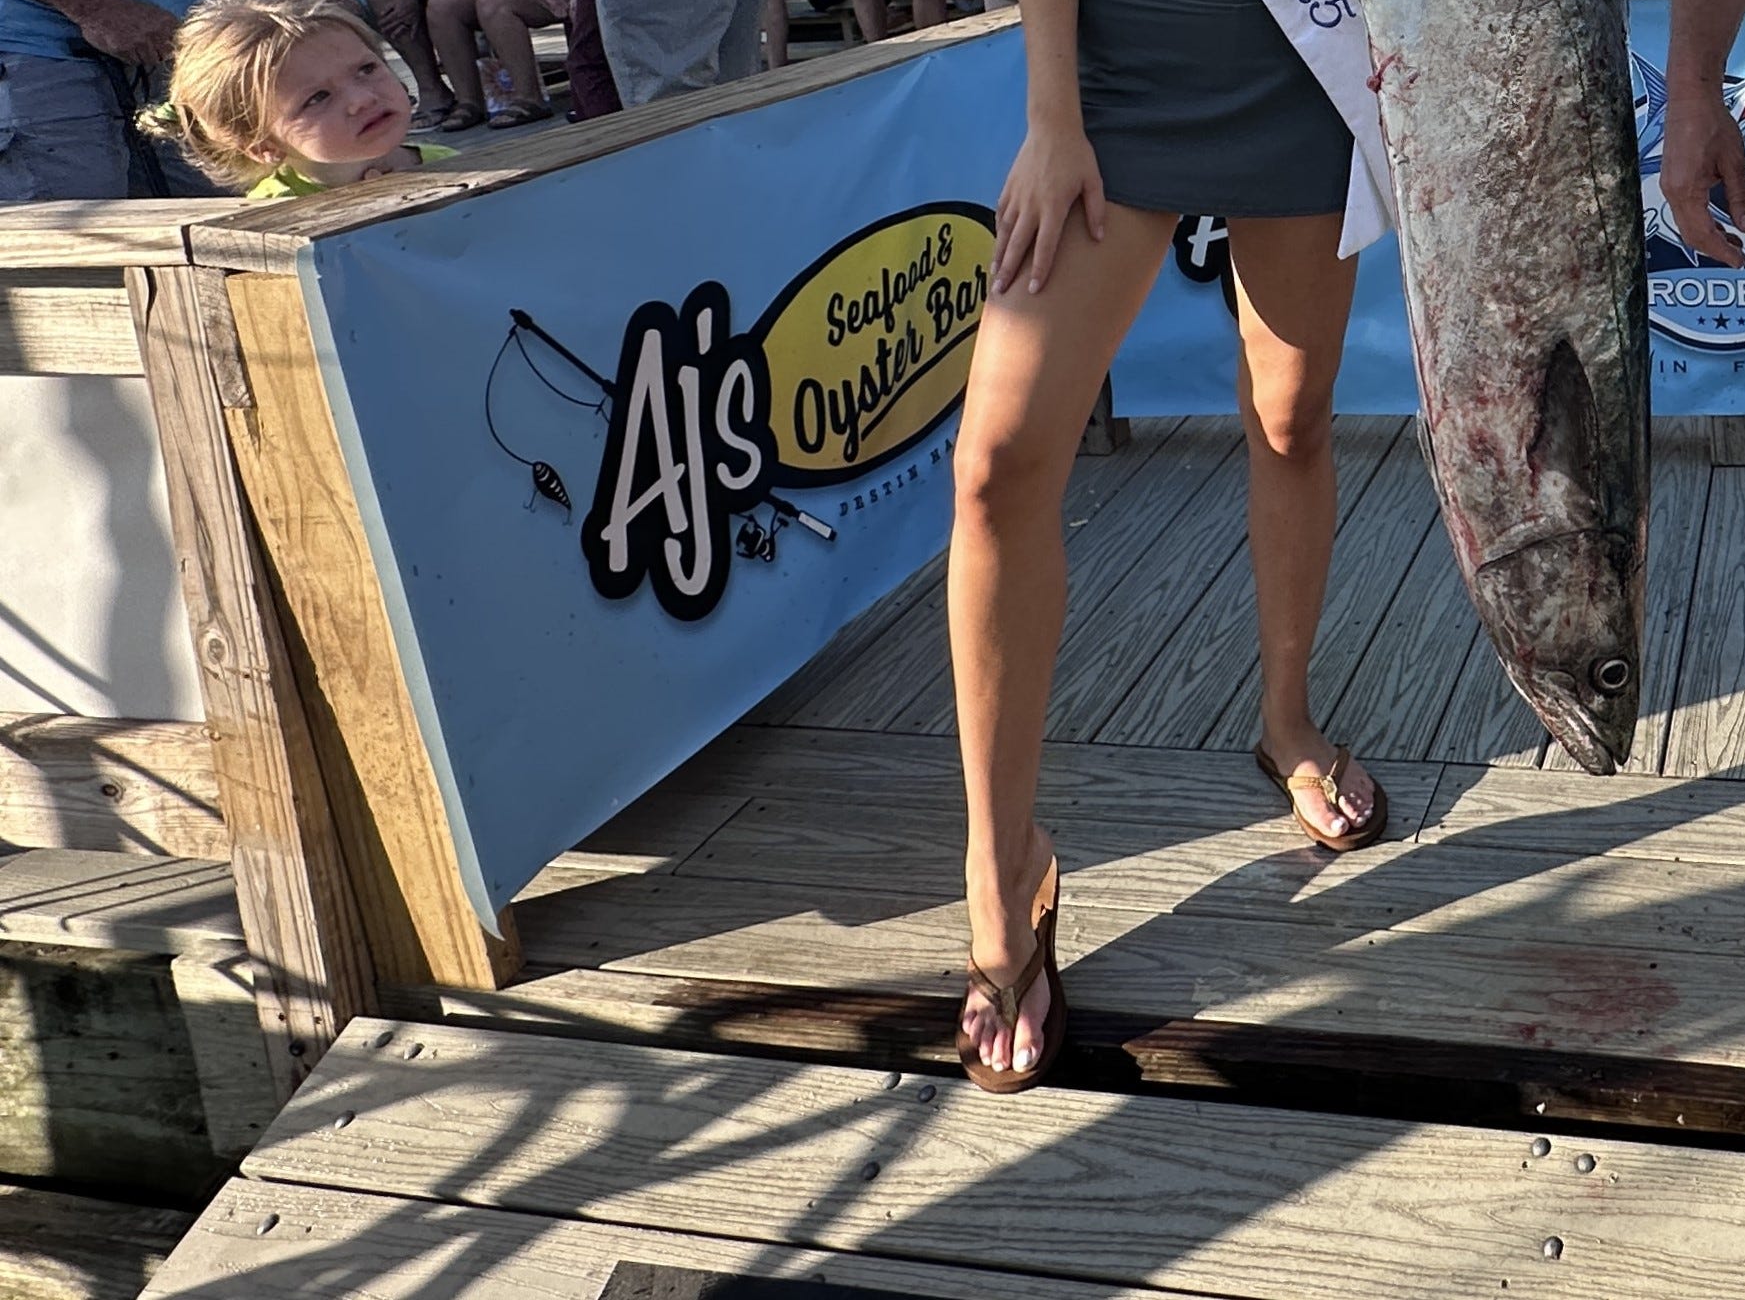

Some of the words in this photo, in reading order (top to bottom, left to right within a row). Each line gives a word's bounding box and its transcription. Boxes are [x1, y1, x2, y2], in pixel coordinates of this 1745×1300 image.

[827, 237, 936, 347] Seafood
[934, 223, 954, 266] &
[793, 328, 924, 463] Oyster
[925, 264, 990, 345] Bar
[839, 463, 918, 517] DESTIN
